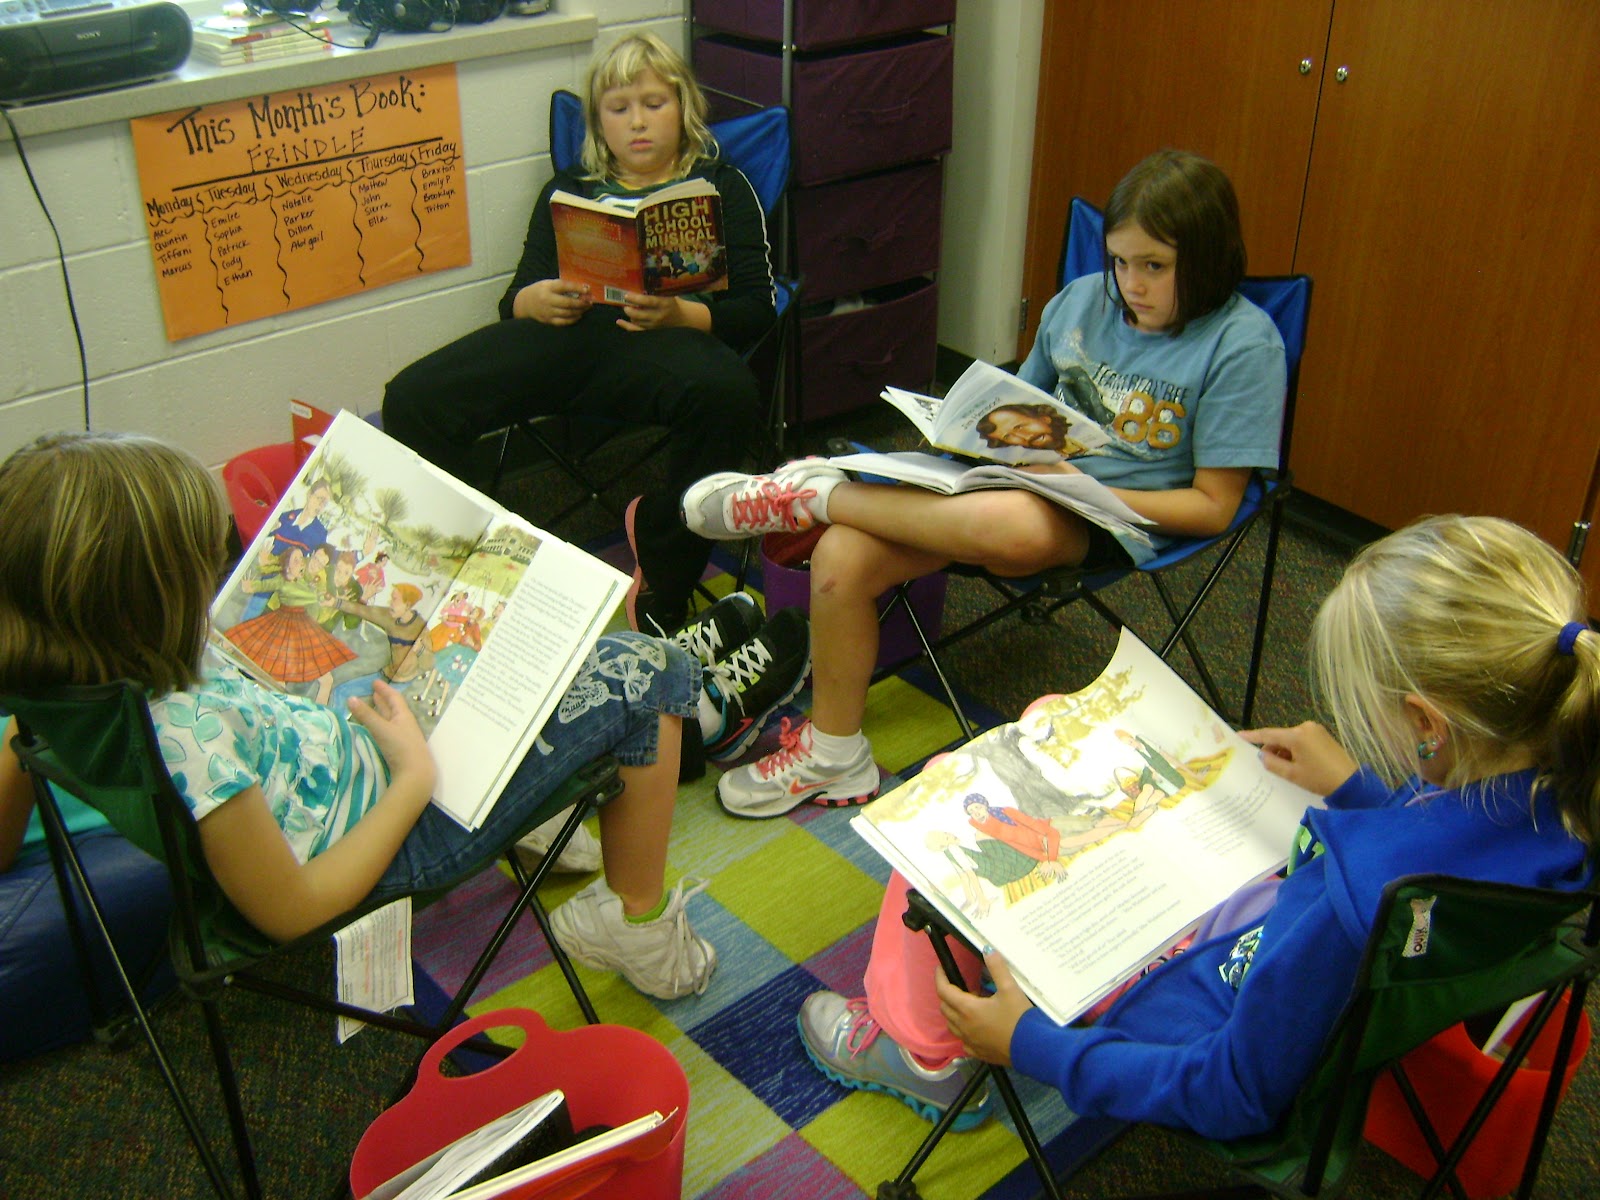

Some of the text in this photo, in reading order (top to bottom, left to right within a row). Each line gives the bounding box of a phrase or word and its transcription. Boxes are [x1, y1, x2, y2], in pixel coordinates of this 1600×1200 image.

[76, 31, 101, 40] SONY
[166, 75, 426, 155] This Month's Book:
[421, 164, 456, 178] Braxton
[146, 142, 457, 218] Monday Tuesday Wednesday Thursday Friday
[422, 175, 451, 191] Emily P
[282, 194, 314, 211] Natalie
[361, 193, 381, 206] John
[423, 188, 456, 202] Brooklyn
[283, 209, 315, 226] Parker
[644, 199, 709, 226] HIGH
[213, 225, 243, 241] Sophia
[287, 223, 314, 238] Dillon
[644, 214, 713, 237] SCHOOL
[290, 230, 324, 252] Abigail
[645, 227, 716, 249] MUSICAL
[217, 239, 250, 257] Patrick
[162, 261, 193, 278] Marcus
[221, 255, 243, 270] Cody
[1112, 390, 1187, 449] 86
